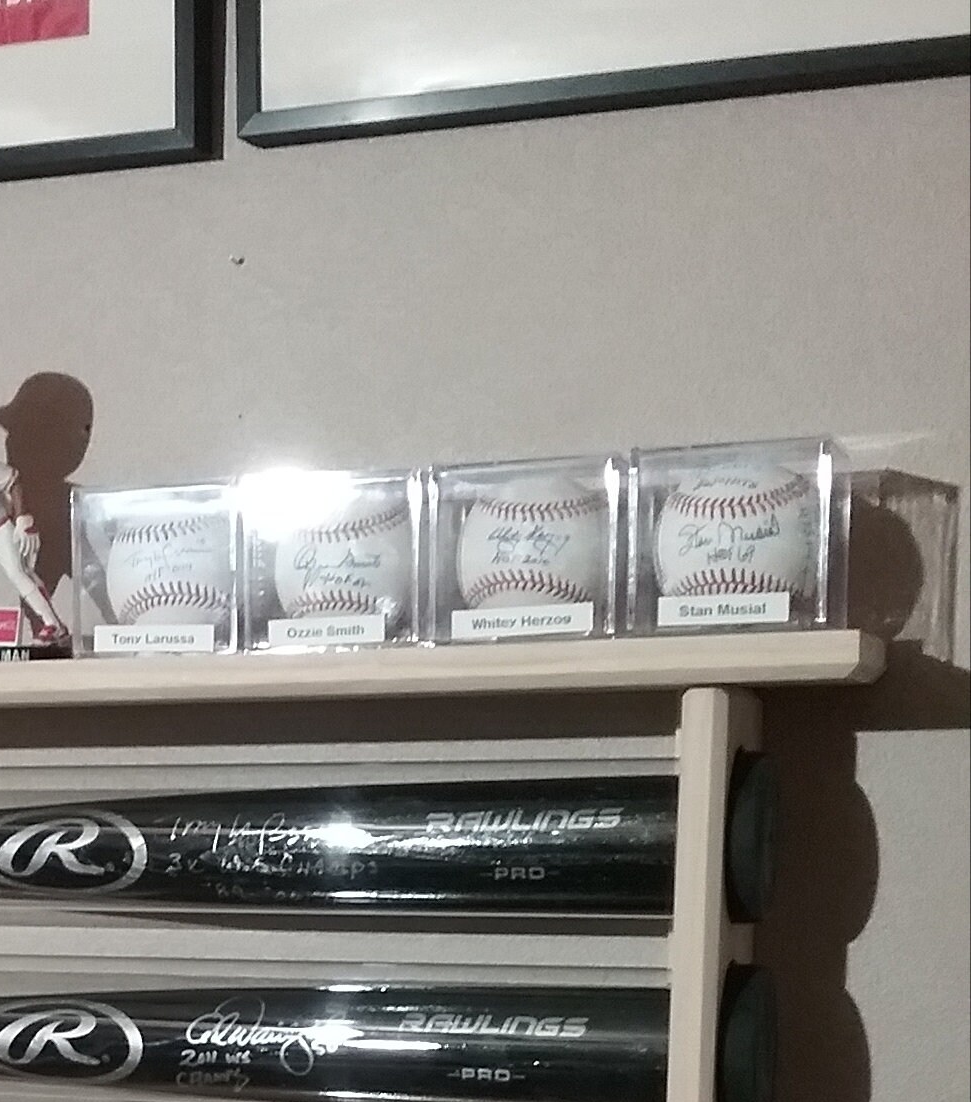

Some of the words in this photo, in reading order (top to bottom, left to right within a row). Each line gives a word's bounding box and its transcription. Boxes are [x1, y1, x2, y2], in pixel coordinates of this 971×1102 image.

[679, 604, 713, 617] Stan
[717, 602, 767, 615] Musial
[472, 617, 516, 630] Whitey
[521, 614, 572, 627] Herzog
[287, 626, 323, 638] Ozzie
[327, 624, 365, 637] Smith
[112, 634, 142, 645] Tony
[146, 633, 195, 645] Larussa
[426, 807, 625, 832] RAWLINGS
[398, 1013, 589, 1037] RAWLINGS
